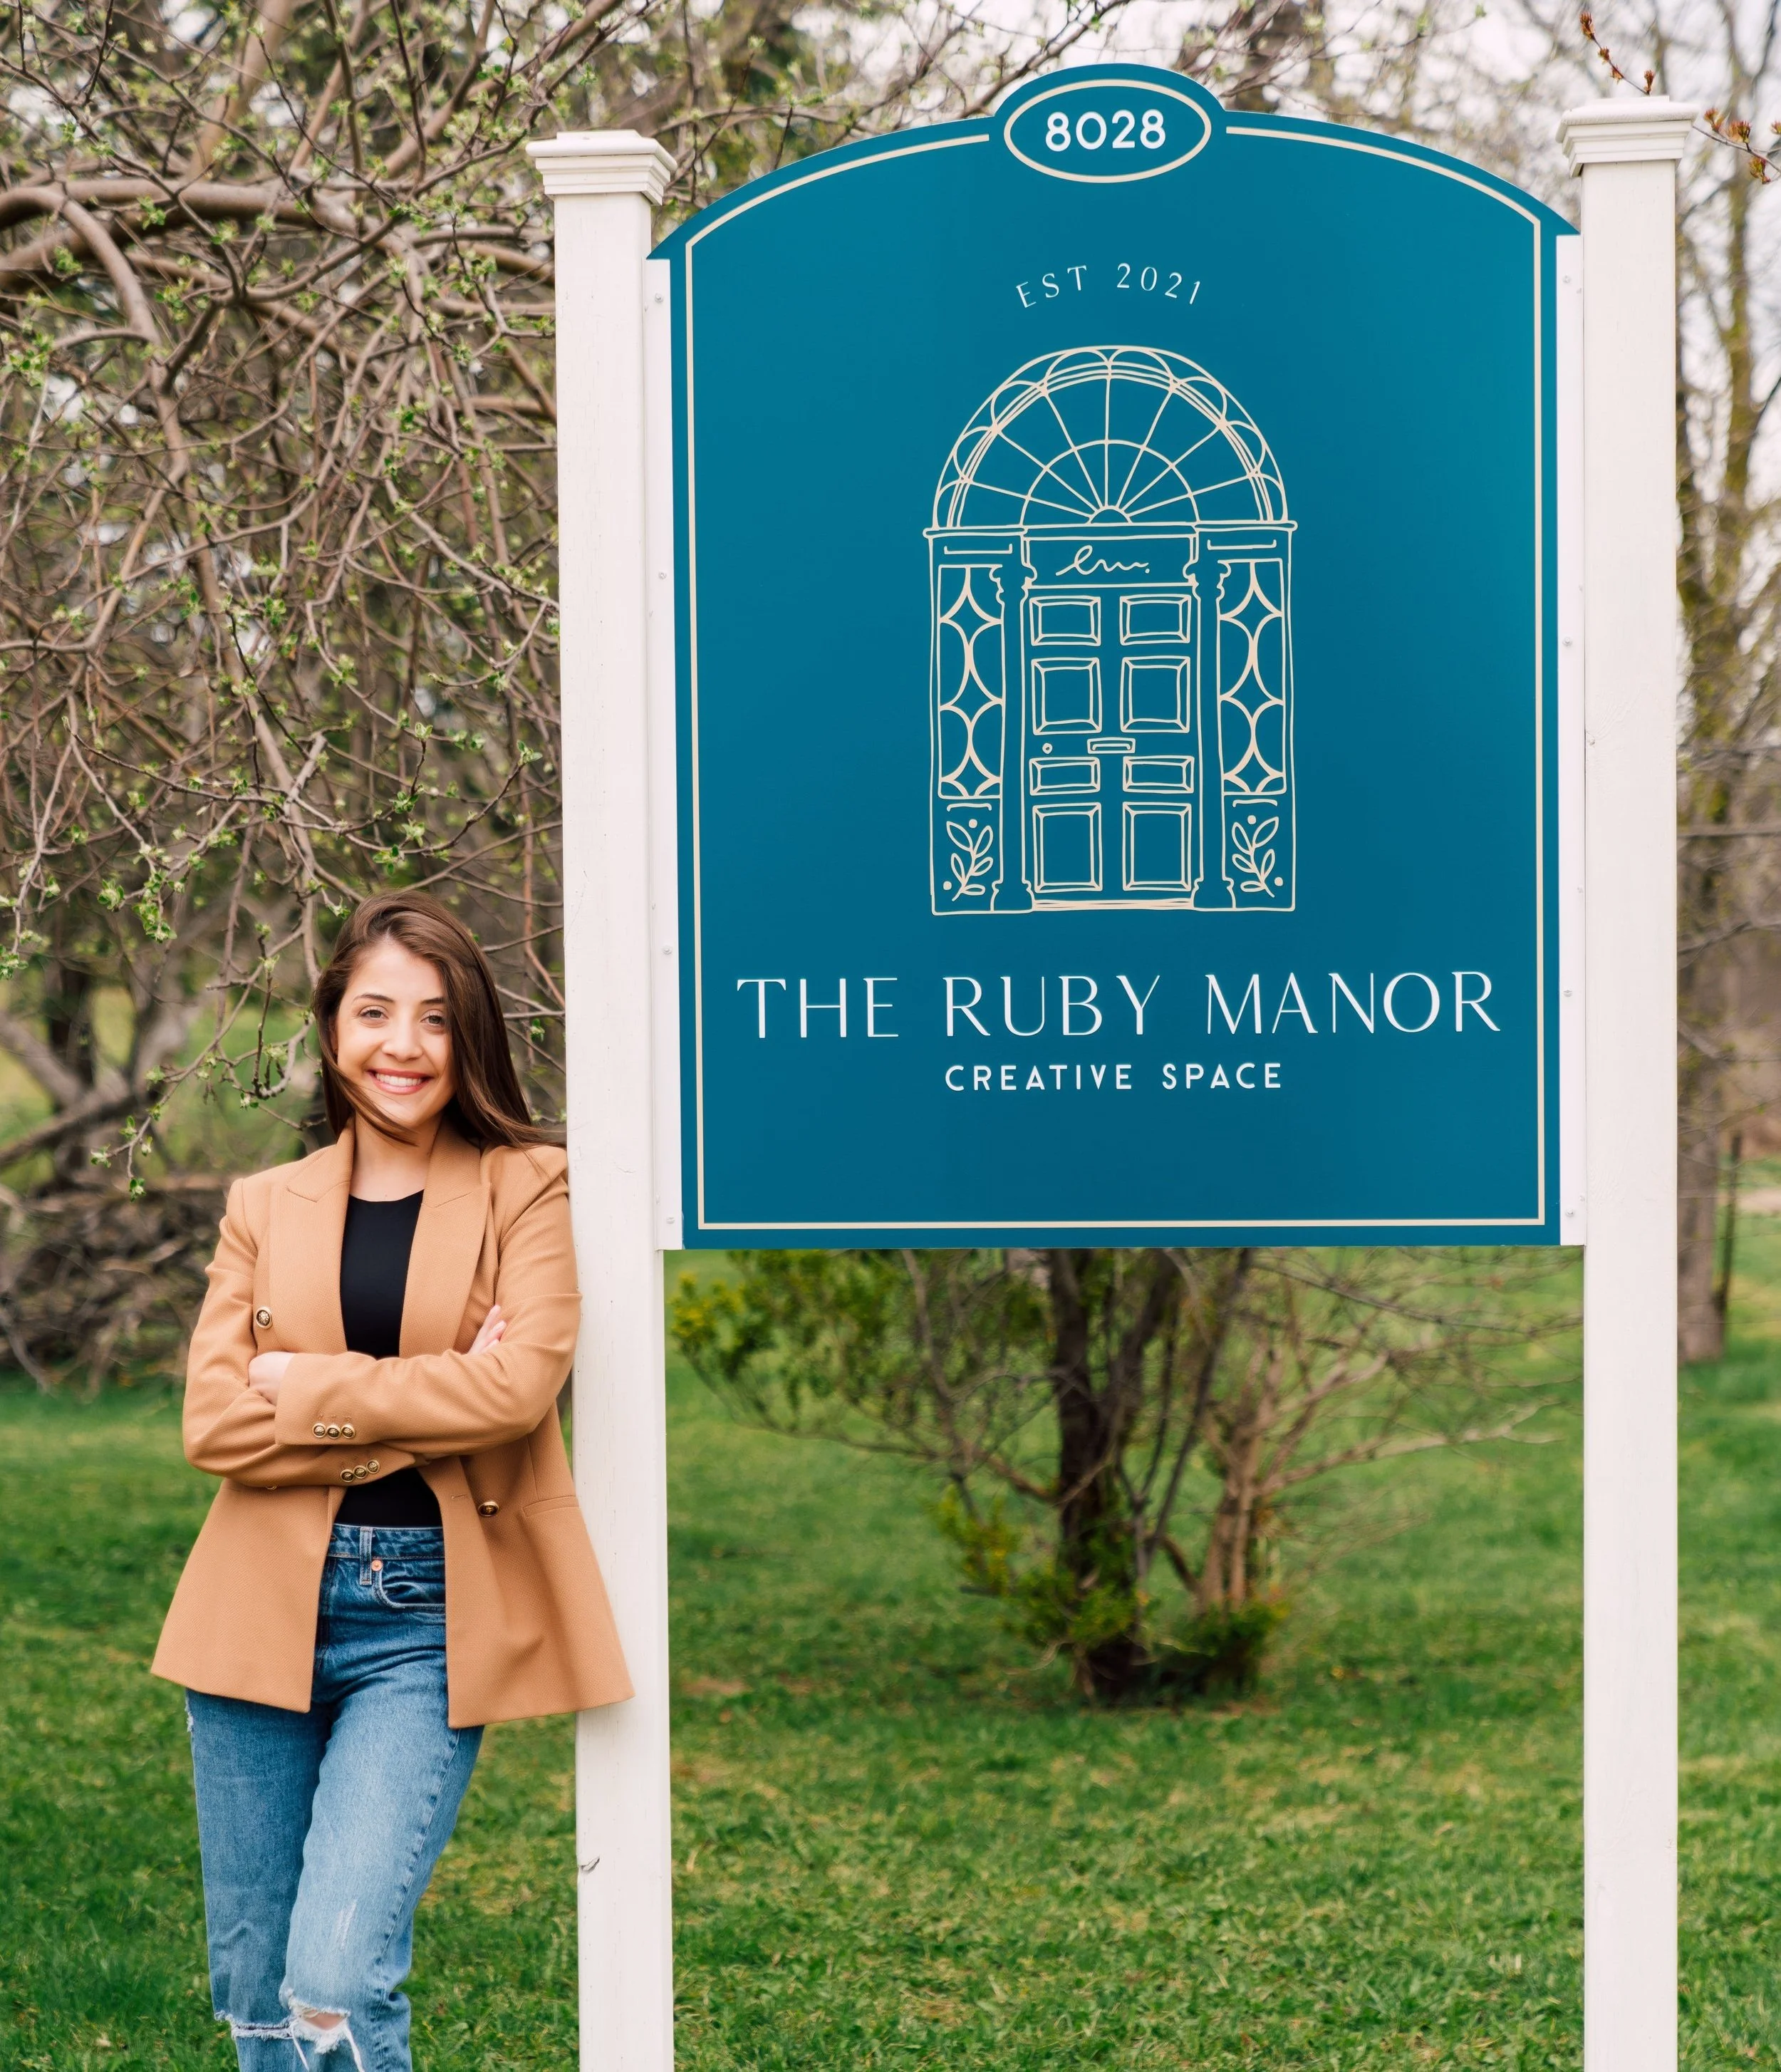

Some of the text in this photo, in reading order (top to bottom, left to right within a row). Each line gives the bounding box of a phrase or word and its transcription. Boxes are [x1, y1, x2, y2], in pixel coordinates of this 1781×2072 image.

[1044, 108, 1166, 152] 8028
[1015, 261, 1201, 309] EST 2021
[736, 970, 1501, 1040] THE RUBY MANOR
[945, 1062, 1282, 1092] CREATIVE SPACE
